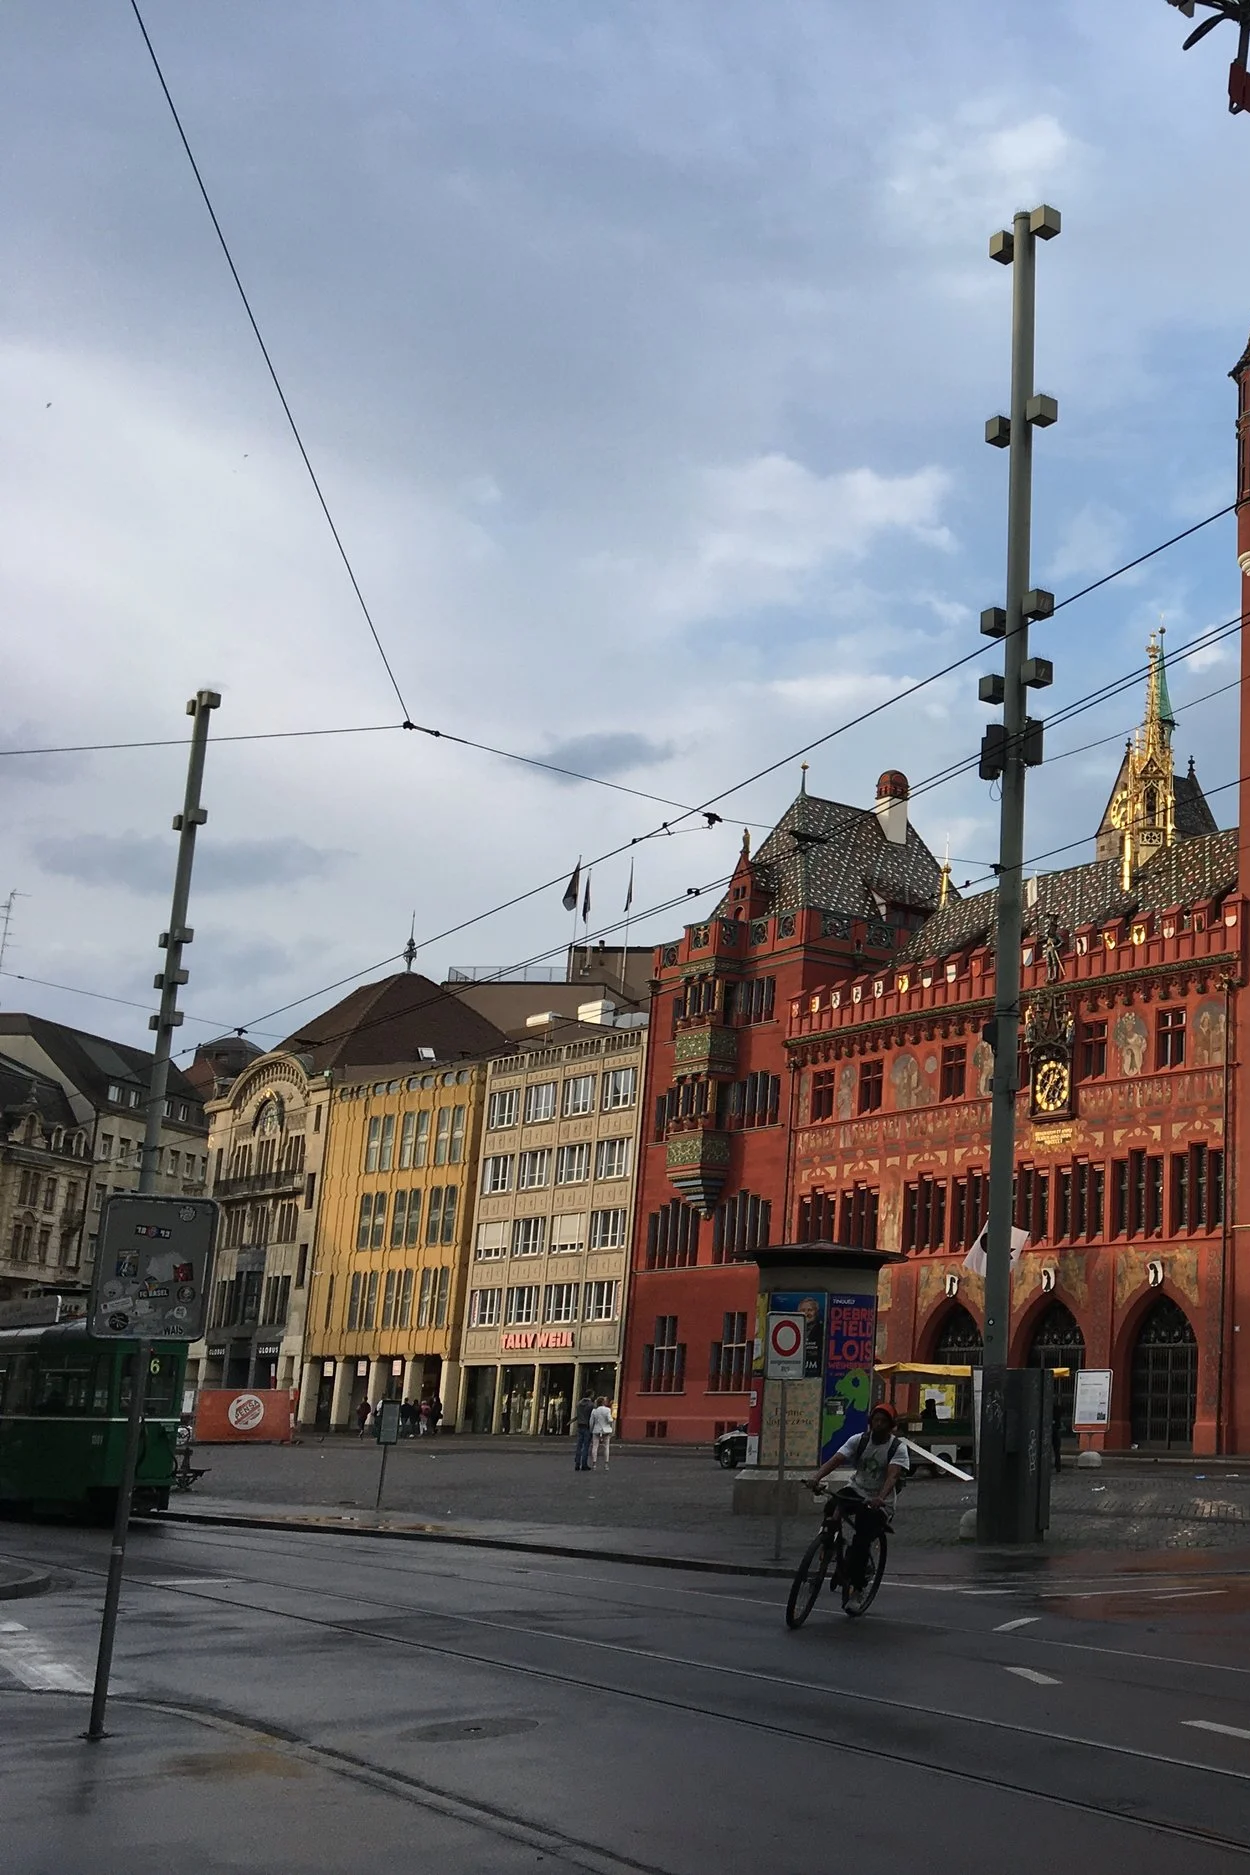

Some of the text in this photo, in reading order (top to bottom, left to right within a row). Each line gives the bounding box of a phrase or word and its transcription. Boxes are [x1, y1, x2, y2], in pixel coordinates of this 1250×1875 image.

[831, 1307, 874, 1321] DEBRIS
[830, 1321, 872, 1337] FIELD
[500, 1333, 535, 1350] TALLY
[258, 1346, 279, 1354] GLOBUS
[829, 1340, 873, 1361] LOIS
[149, 1358, 161, 1375] 6
